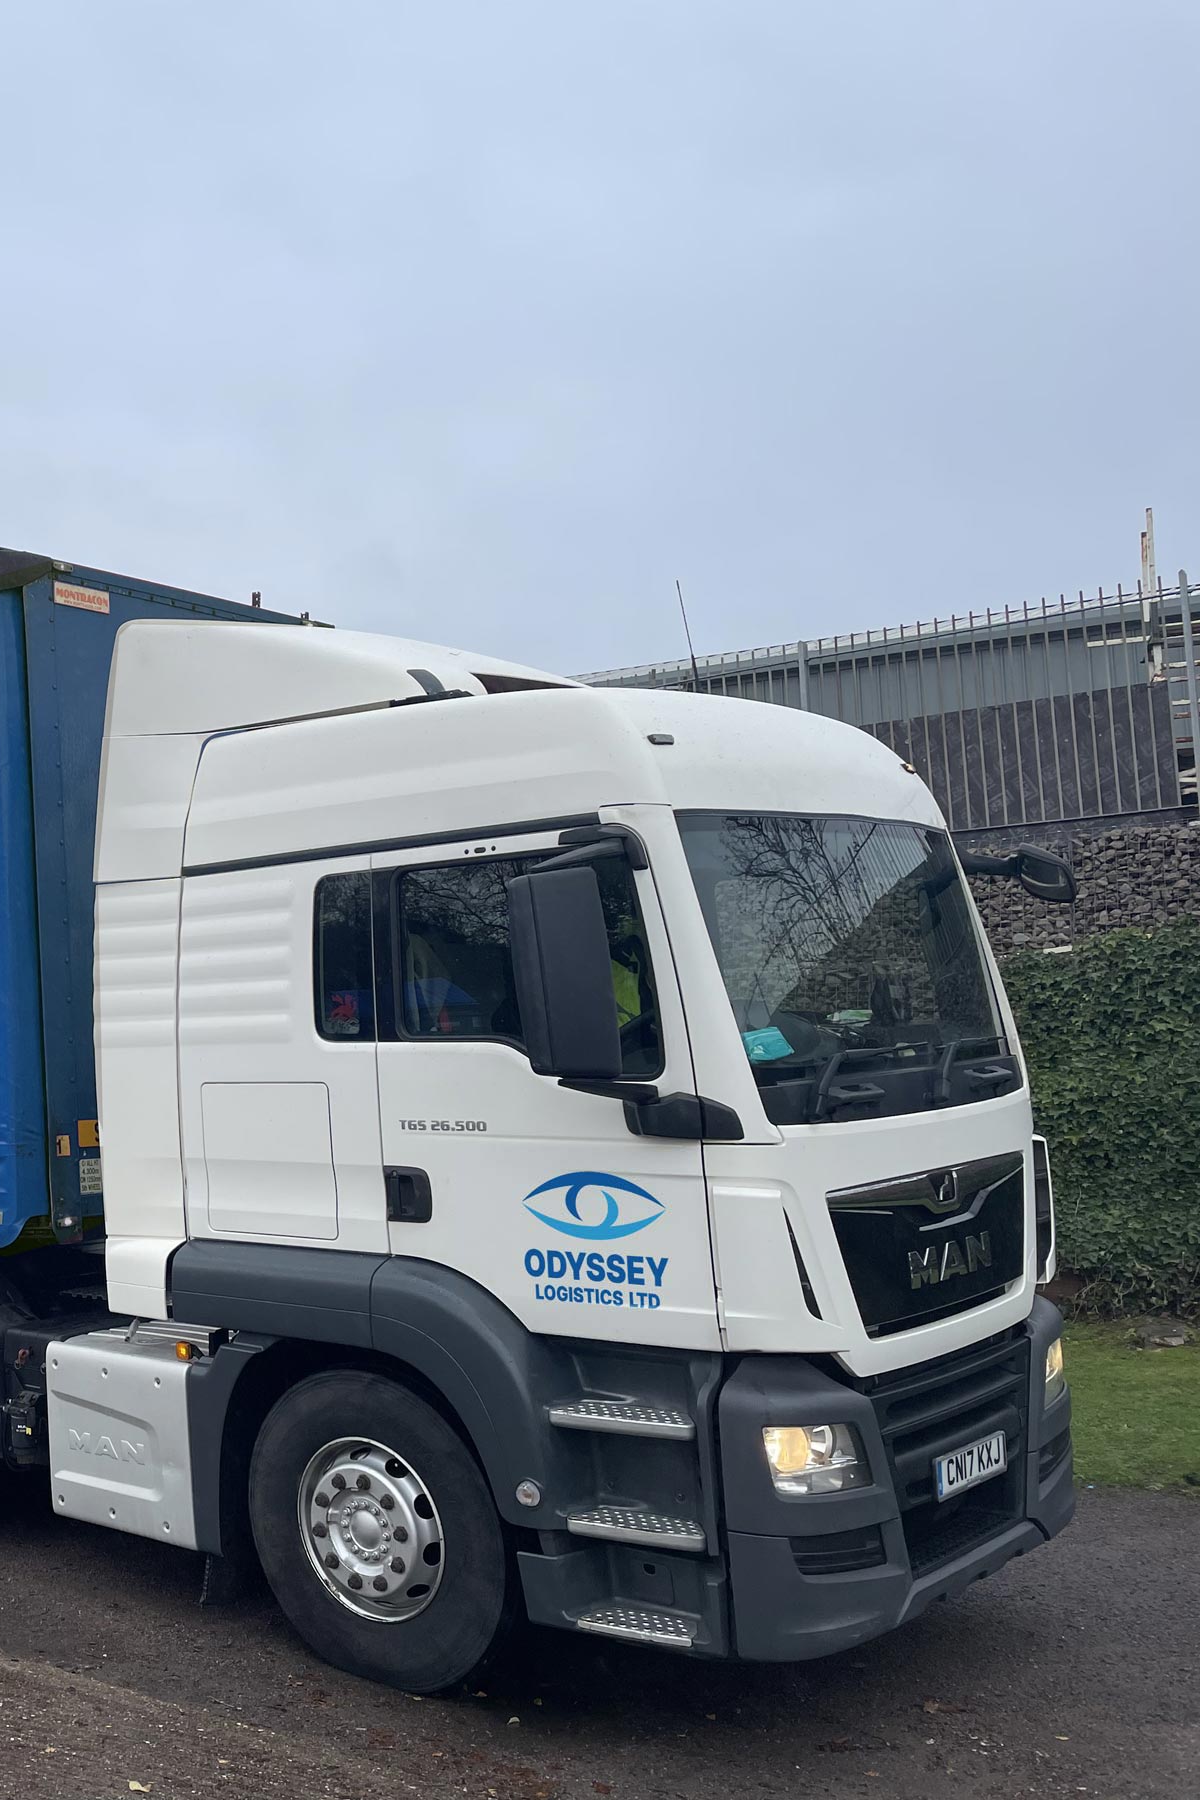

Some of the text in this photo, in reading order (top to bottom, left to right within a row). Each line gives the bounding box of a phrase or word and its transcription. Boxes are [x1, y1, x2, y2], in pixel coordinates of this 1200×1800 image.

[431, 1120, 487, 1132] 26.500
[524, 1248, 668, 1287] ODYSSEY
[908, 1231, 992, 1289] MAN
[535, 1284, 660, 1309] LOGISTICS LTD
[69, 1429, 145, 1465] MAN
[977, 1438, 1000, 1473] KXJ
